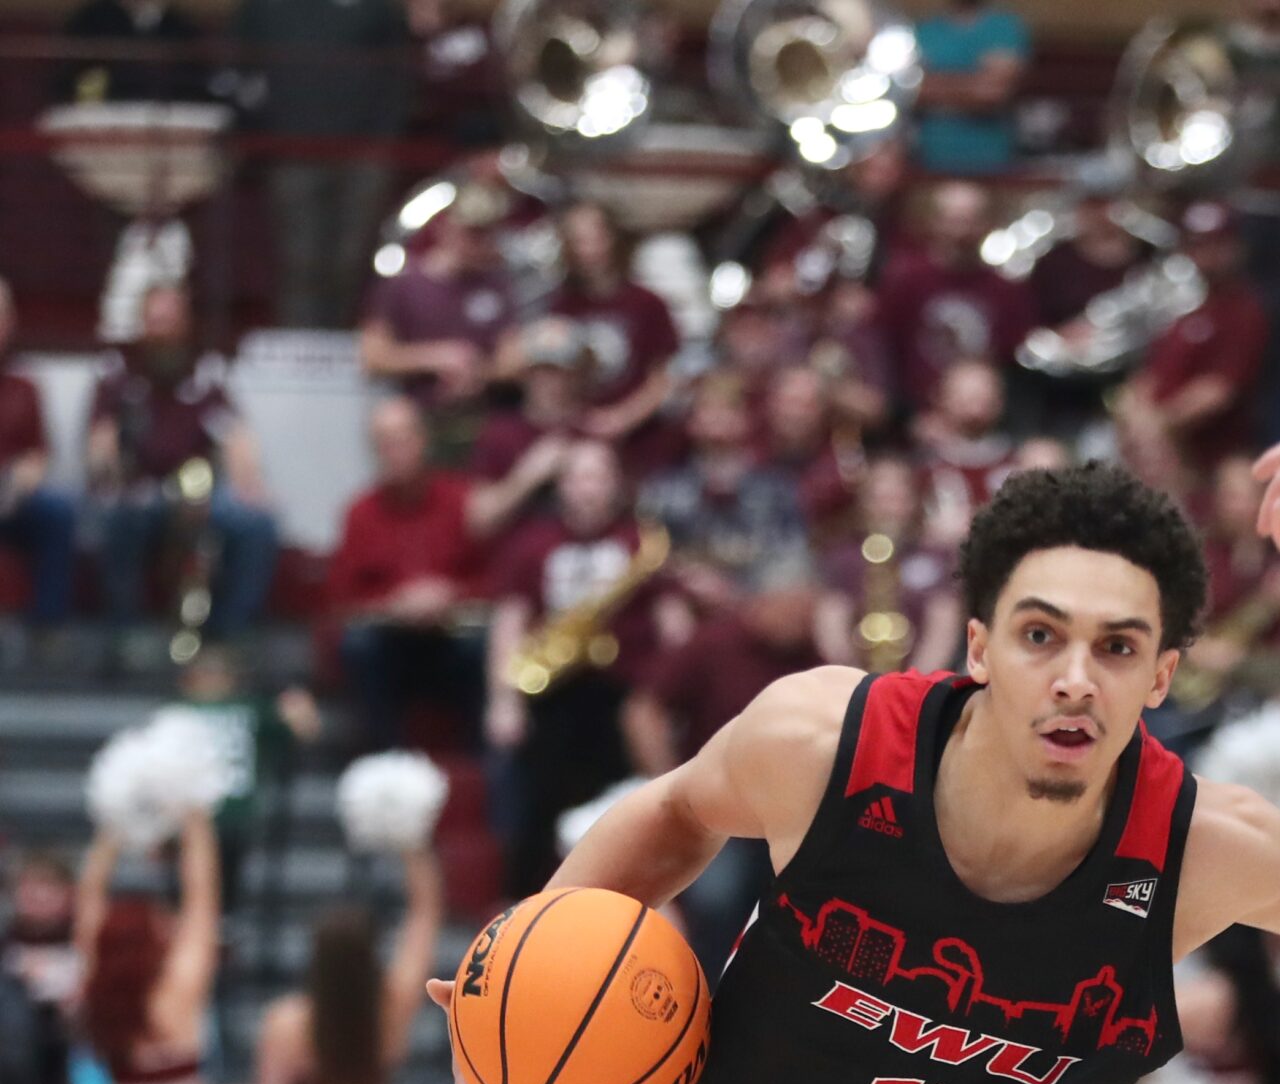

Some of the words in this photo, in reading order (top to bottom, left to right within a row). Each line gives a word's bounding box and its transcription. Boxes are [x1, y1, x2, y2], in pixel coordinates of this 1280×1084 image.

[857, 815, 904, 839] adidas
[1125, 882, 1153, 901] SKY
[462, 903, 516, 997] NCA
